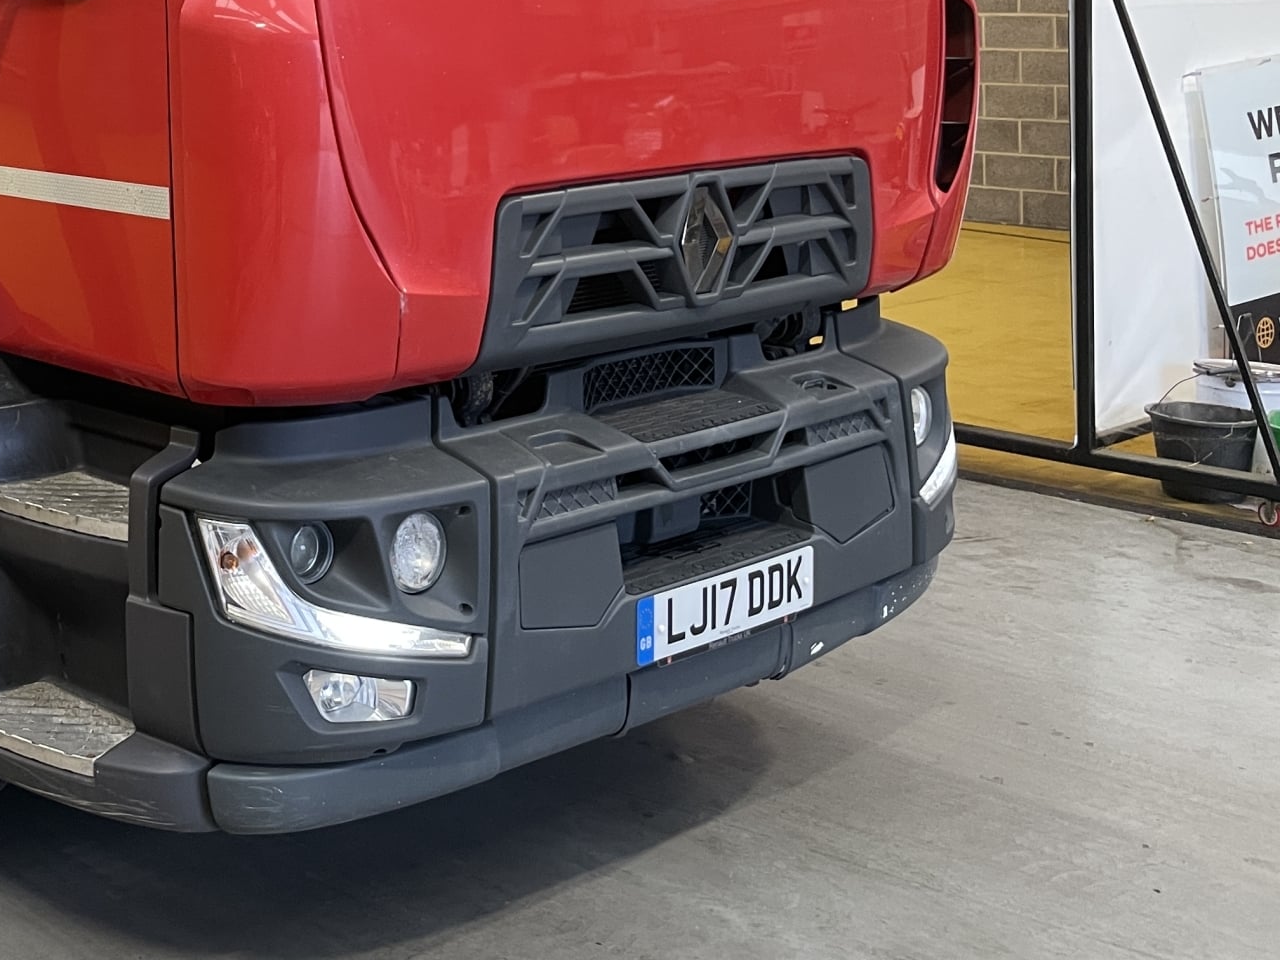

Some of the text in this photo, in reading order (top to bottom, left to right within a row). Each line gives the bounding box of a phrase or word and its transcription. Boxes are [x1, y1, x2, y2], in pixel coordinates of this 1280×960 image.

[1245, 216, 1274, 236] THE
[667, 555, 804, 645] LJ17 DDK
[639, 635, 653, 651] GB
